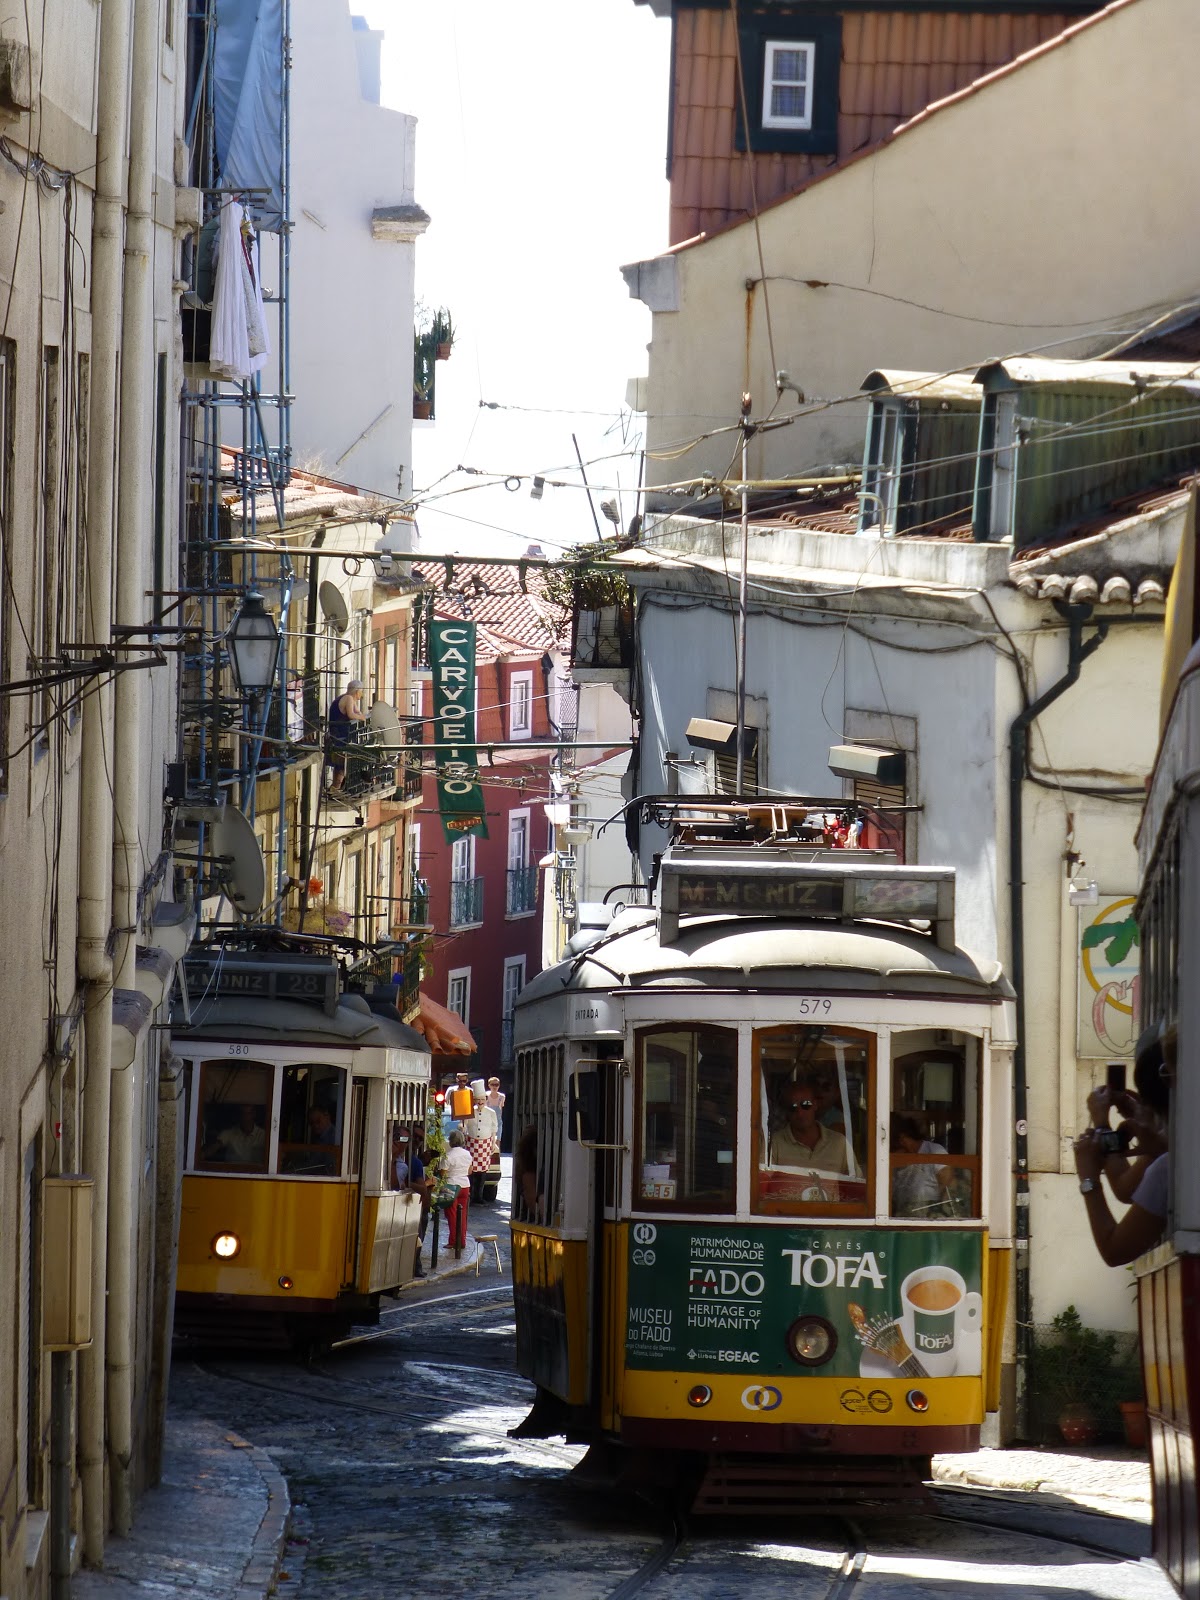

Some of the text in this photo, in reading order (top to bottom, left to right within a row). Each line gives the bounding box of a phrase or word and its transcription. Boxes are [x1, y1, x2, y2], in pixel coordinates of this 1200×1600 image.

[438, 628, 473, 795] CARVOEIRO
[289, 975, 318, 993] 28
[799, 1000, 832, 1014] 579
[575, 1008, 599, 1021] ENTRADA
[228, 1045, 249, 1055] 580
[690, 1237, 751, 1249] PATRIMÓNIO
[812, 1240, 861, 1250] CAFÉS
[690, 1248, 764, 1261] HUMANIDADE
[781, 1248, 888, 1289] TOFA
[688, 1268, 765, 1296] FADO
[629, 1307, 672, 1325] MUSEU
[688, 1304, 761, 1317] HERITAGE OF
[687, 1316, 761, 1330] HUMANITY
[628, 1325, 671, 1342] DO FADO
[916, 1332, 952, 1349] TOFA
[697, 1352, 717, 1360] Lisboa
[718, 1350, 760, 1363] EGEAC
